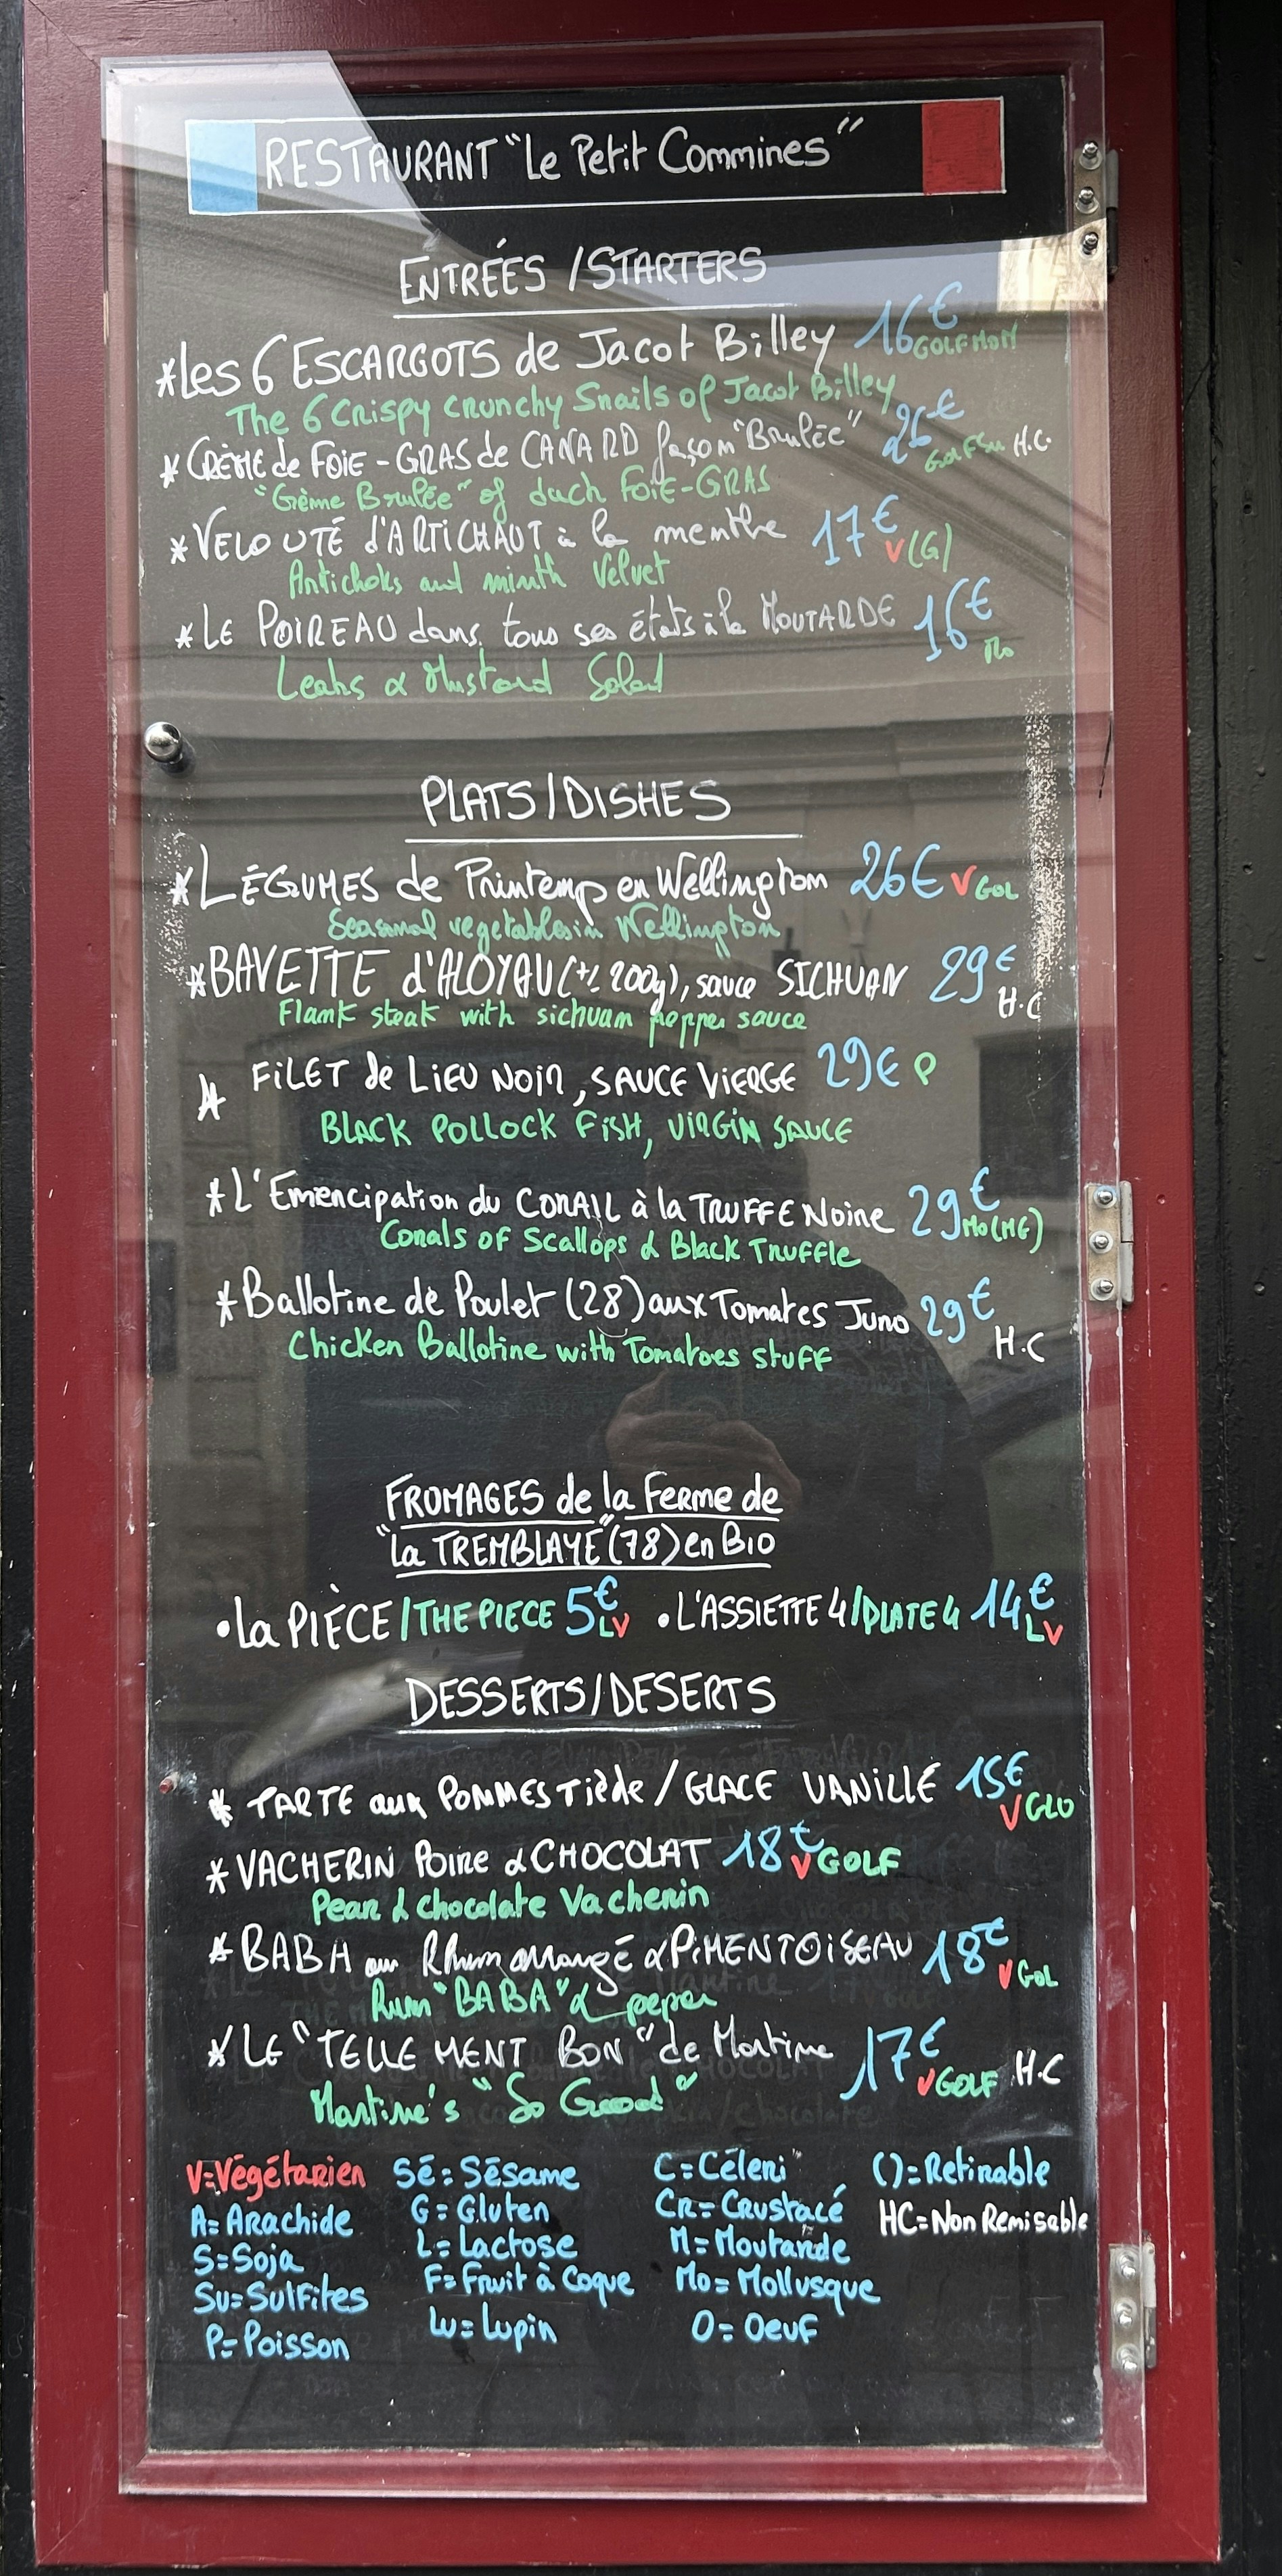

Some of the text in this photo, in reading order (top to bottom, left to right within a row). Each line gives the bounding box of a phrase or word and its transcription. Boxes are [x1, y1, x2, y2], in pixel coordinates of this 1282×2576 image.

[265, 136, 498, 189] RESTAURANT
[570, 130, 647, 177] Petit
[399, 238, 545, 304] ENTRÉES
[252, 334, 287, 395] 6
[293, 337, 501, 390] ESCARGOTS
[515, 332, 559, 376] de
[576, 324, 693, 369] Jacot
[714, 313, 835, 375] Billey
[226, 402, 290, 436] The
[302, 392, 329, 433] 6
[330, 402, 431, 436] Crispy
[572, 381, 670, 411] Snails
[679, 374, 716, 421] of
[723, 371, 799, 409] Jacot
[812, 362, 896, 413] Billey
[272, 438, 300, 479] de
[477, 430, 509, 469] de
[521, 422, 639, 470] CANARD
[480, 477, 507, 523] of
[654, 502, 787, 545] menthe
[812, 494, 899, 566] 17€
[913, 576, 992, 661] 16€
[200, 844, 380, 910] LÉGUMES
[396, 853, 443, 904] de
[617, 872, 650, 902] en
[657, 851, 829, 920] Wellington
[849, 840, 944, 901] 26€
[208, 943, 391, 999] BAVETTE
[696, 975, 757, 1000] sauce
[777, 958, 909, 1002] SICHUAN
[929, 945, 1016, 1004] 29€
[370, 999, 440, 1029] steak
[460, 1001, 515, 1028] with
[737, 1011, 807, 1031] sauce
[365, 1052, 394, 1092] de
[817, 1035, 900, 1092] 29€
[321, 1110, 411, 1147] BLACK
[773, 1117, 853, 1150] SAUCE
[468, 1184, 501, 1214] du
[631, 1189, 649, 1219] à
[658, 1186, 687, 1222] la
[908, 1167, 1001, 1241] 29€
[523, 1225, 628, 1262] Scallops
[670, 1229, 739, 1263] Black
[242, 1265, 396, 1319] Ballotine
[404, 1276, 444, 1317] de
[455, 1269, 556, 1319] Poulet
[647, 1293, 708, 1319] aux
[710, 1287, 828, 1329] Tomates
[919, 1276, 995, 1344] 29€
[288, 1327, 404, 1361] Chicken
[417, 1319, 547, 1363] Ballotine
[555, 1326, 616, 1363] with
[622, 1332, 740, 1368] Tomatoes
[385, 1472, 545, 1521] FROMAGES
[555, 1472, 593, 1515] de
[603, 1470, 635, 1509] la
[741, 1472, 783, 1516] de
[683, 1534, 714, 1559] en
[479, 1597, 555, 1633] PIECE
[247, 1783, 354, 1820] TARTE
[955, 1751, 1028, 1800] 15€
[530, 1836, 712, 1876] CHOCOLAT
[242, 1923, 352, 1975] BABA
[659, 2022, 701, 2064] de
